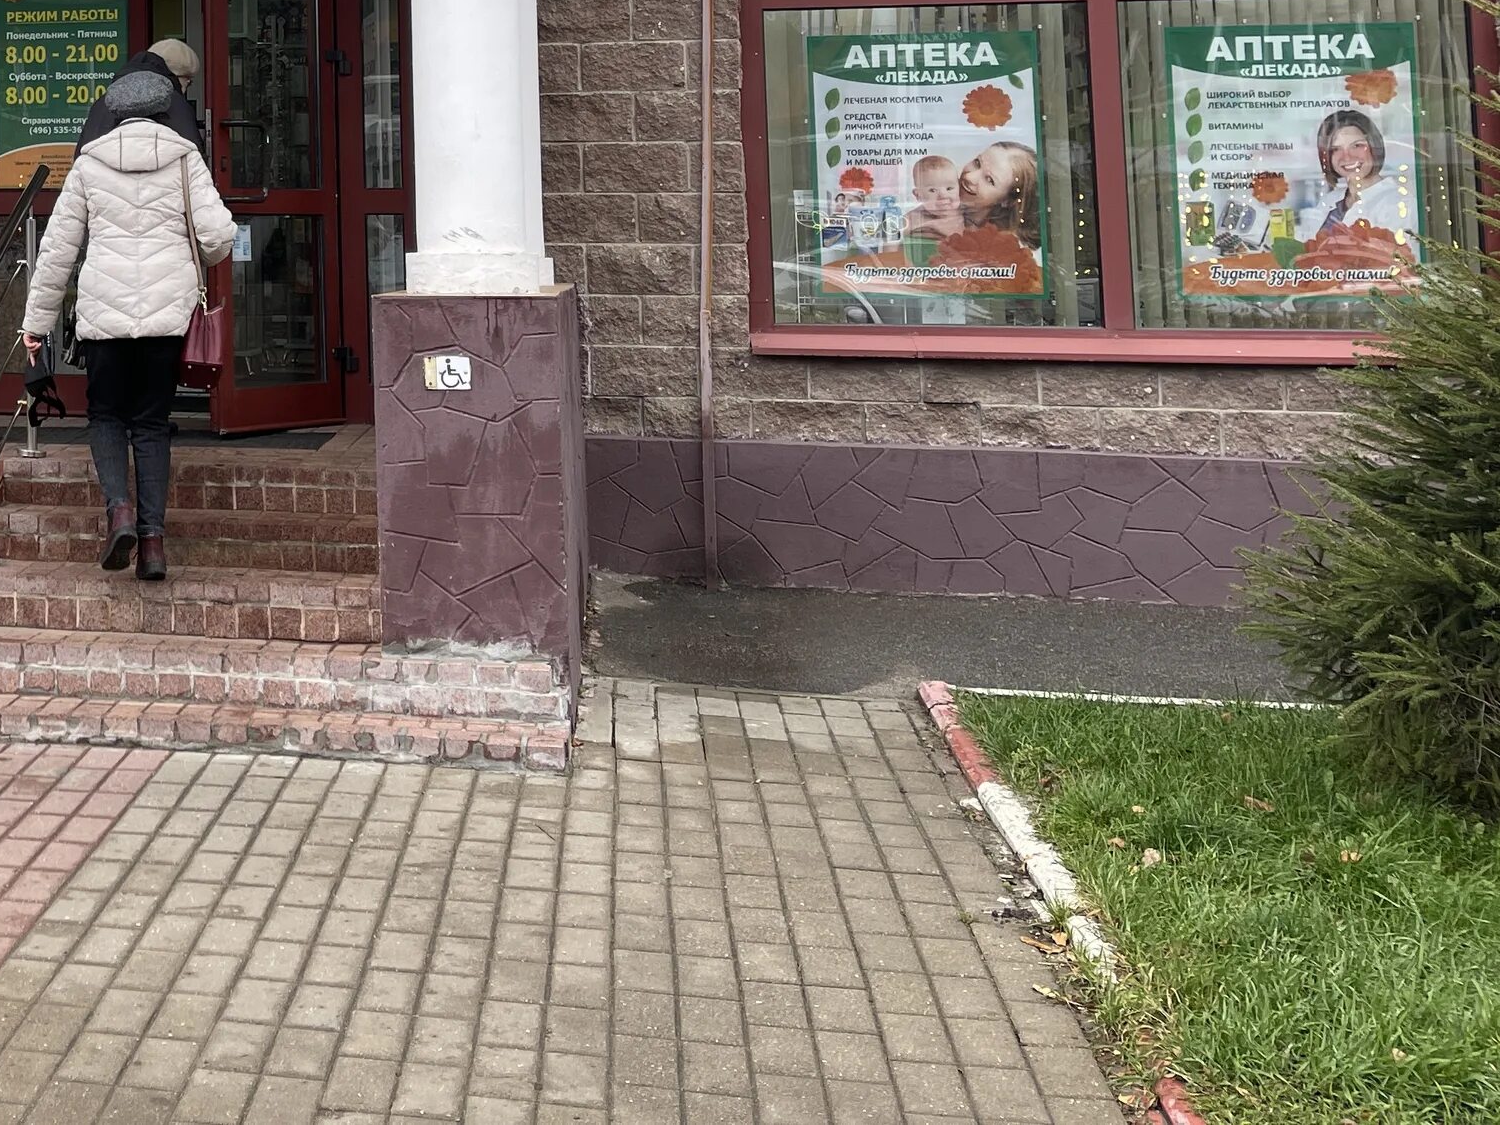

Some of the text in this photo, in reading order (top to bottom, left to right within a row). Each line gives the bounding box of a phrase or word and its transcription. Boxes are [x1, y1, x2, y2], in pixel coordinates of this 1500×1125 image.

[6, 9, 118, 22] РЕЖИМ РАБОТЫ
[6, 31, 69, 40] Понедельник
[77, 30, 118, 39] Пятница
[1206, 33, 1375, 62] АПТЕКА
[5, 45, 46, 64] 8.00
[66, 44, 118, 63] 21.00
[844, 41, 1000, 69] АПТЕКА
[1239, 63, 1342, 78] «ЛЕКАДА»
[9, 73, 47, 82] Суббота
[55, 72, 115, 80] Воскресенье
[875, 70, 968, 84] «ЛЕКАДА»
[5, 86, 47, 105] 8.00
[66, 85, 107, 104] 20.0
[1206, 89, 1291, 99] ШИРОКИЙ ВЫБОР
[843, 95, 943, 105] ЛЕЧЕБНАЯ КОСМЕТИКА
[1207, 100, 1350, 109] ЛЕКАРСТВЕННЫХ ПРЕПАРАТОВ
[21, 117, 88, 125] Справочная слу
[844, 113, 887, 122] СРЕДСТВА
[29, 126, 83, 135] (496) 535-36
[844, 121, 924, 131] ЛИЧНОЙ ГИГИЕНЫ
[1208, 122, 1263, 131] ВИТАМИНЫ
[845, 132, 934, 141] И ПРЕДМЕТЫ УХОДА
[1209, 142, 1294, 151] ЛЕЧЕБНЫЕ ТРАВЫ
[846, 148, 928, 158] ТОВАРЫ ДЛЯ МАМ
[1211, 153, 1218, 161] И
[846, 156, 903, 166] И МАЛЫШЕЙ
[1213, 182, 1254, 190] ТЕХНИКА
[845, 263, 1017, 283] Будьте здоровы с нами!
[1209, 265, 1267, 286] Будьте
[1268, 267, 1331, 286] здоровы
[1335, 270, 1345, 280] с
